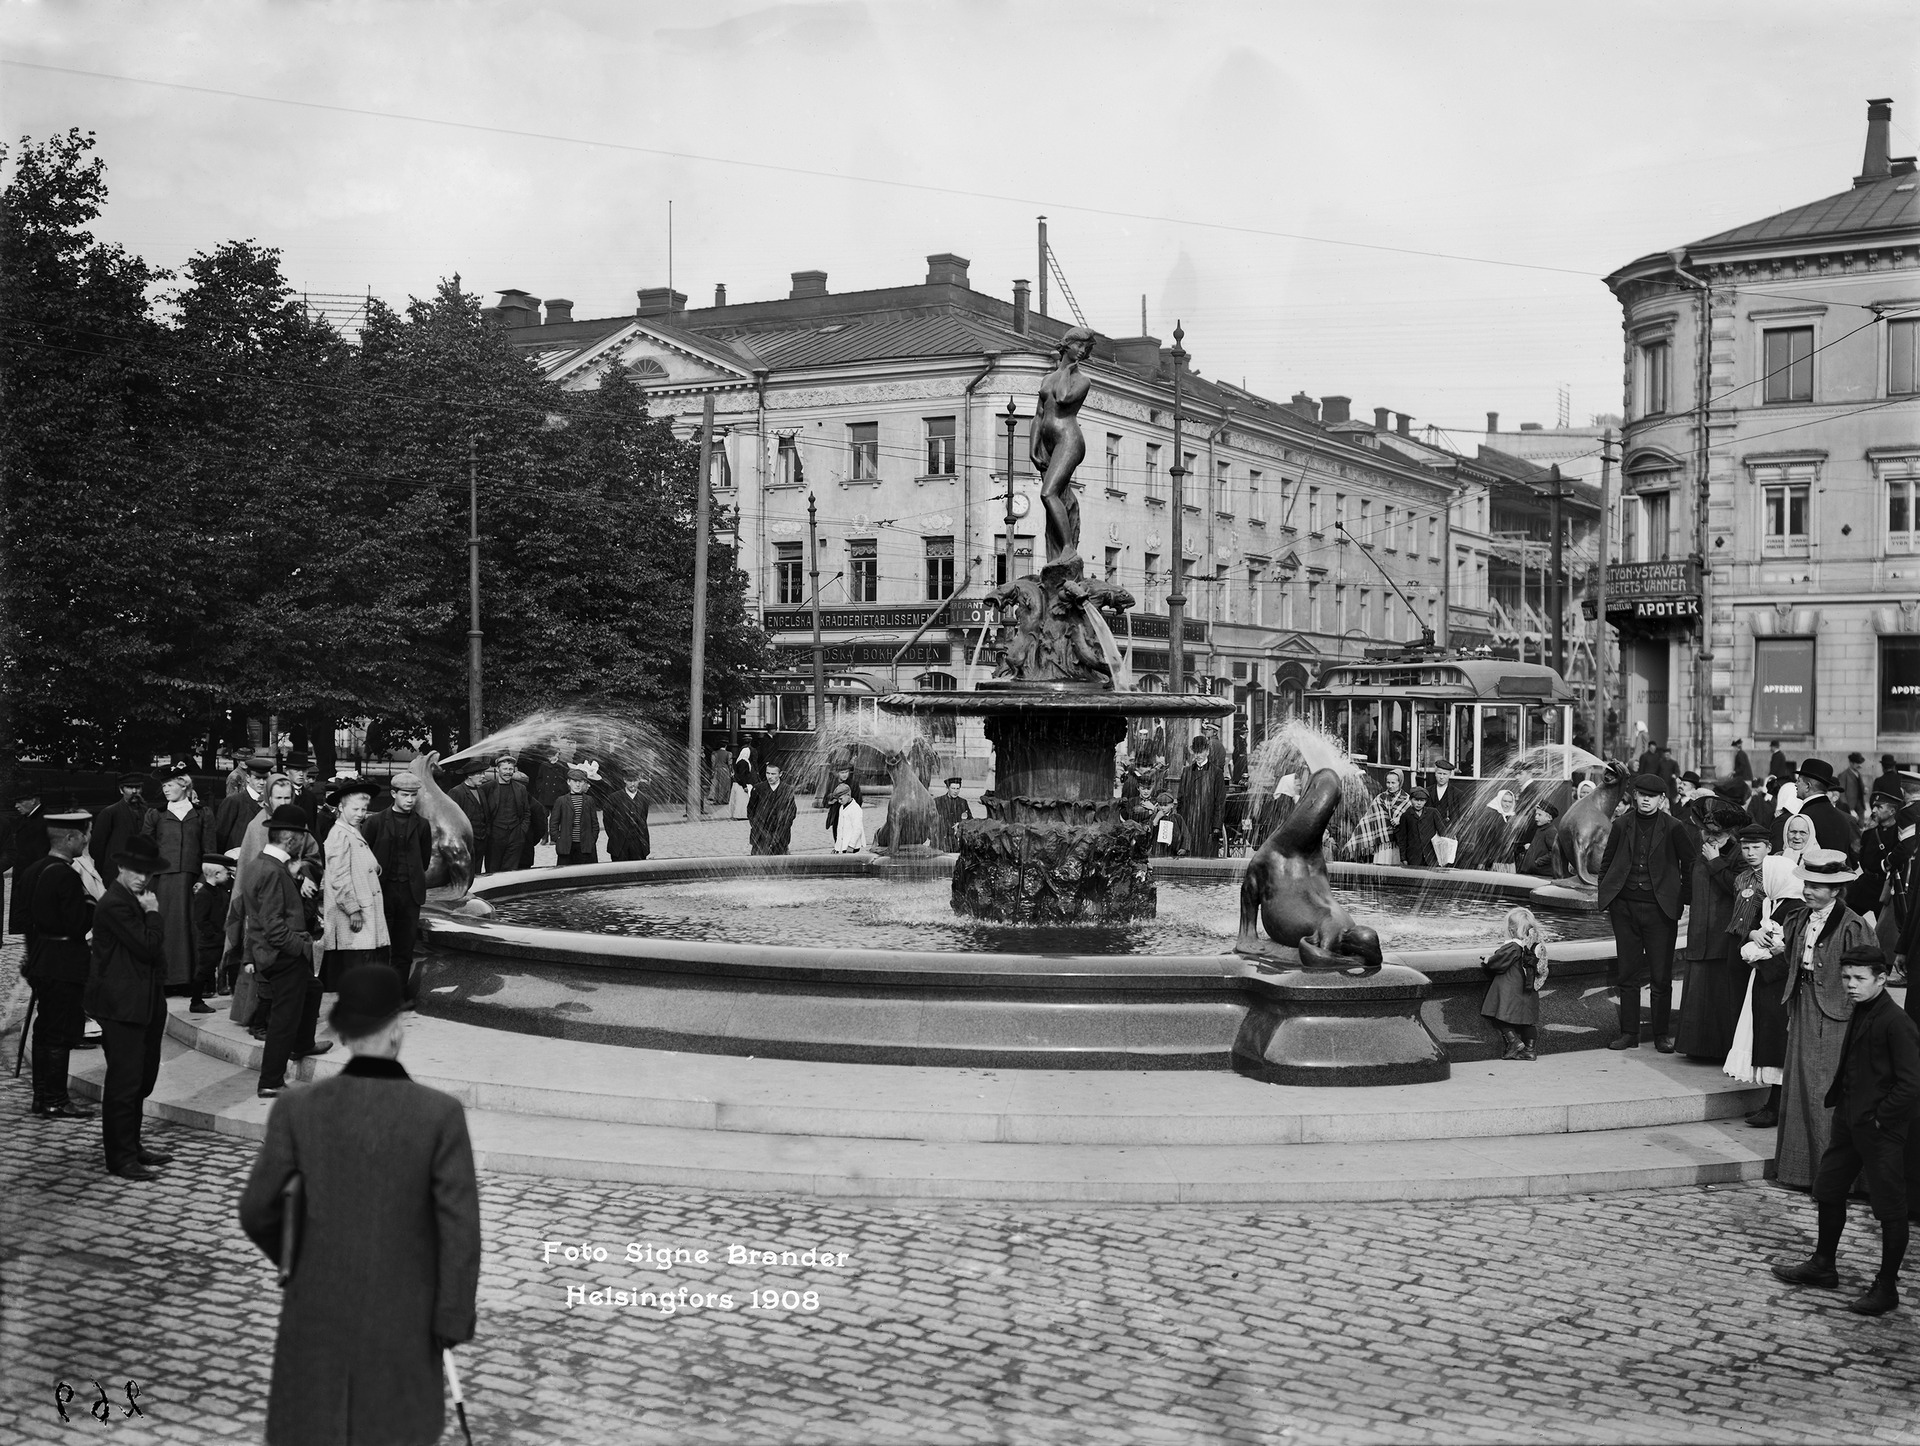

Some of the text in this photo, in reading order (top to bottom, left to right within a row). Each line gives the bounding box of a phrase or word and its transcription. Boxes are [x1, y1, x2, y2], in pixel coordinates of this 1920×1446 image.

[1638, 601, 1699, 616] APOTEK
[767, 615, 812, 627] ENGELSKA
[863, 647, 940, 660] BOKHNDELN
[1763, 684, 1803, 694] APTEEKKI
